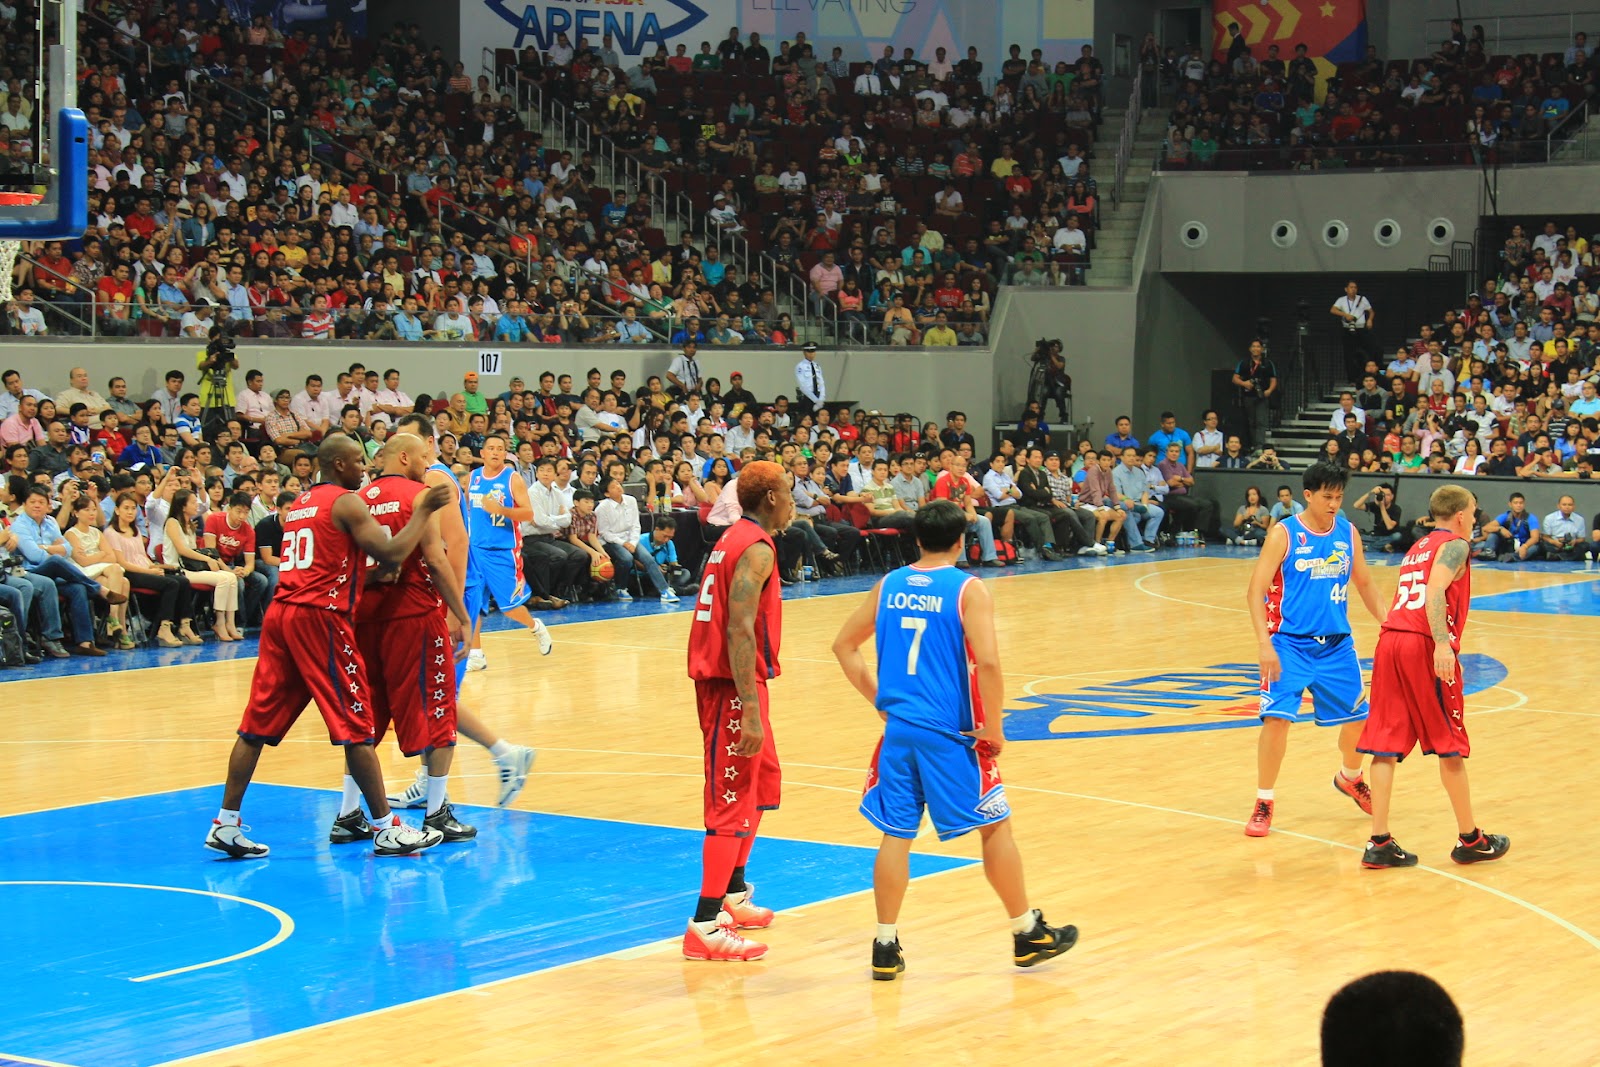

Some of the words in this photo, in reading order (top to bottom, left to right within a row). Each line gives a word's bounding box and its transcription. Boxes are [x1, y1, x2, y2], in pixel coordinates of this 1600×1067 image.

[513, 5, 669, 56] ARENA
[481, 353, 499, 373] 107
[366, 501, 400, 516] ANDER
[489, 513, 506, 527] 12
[279, 527, 314, 572] 30
[887, 592, 943, 613] LOCSIN
[1392, 569, 1427, 611] 55
[900, 616, 928, 675] 7
